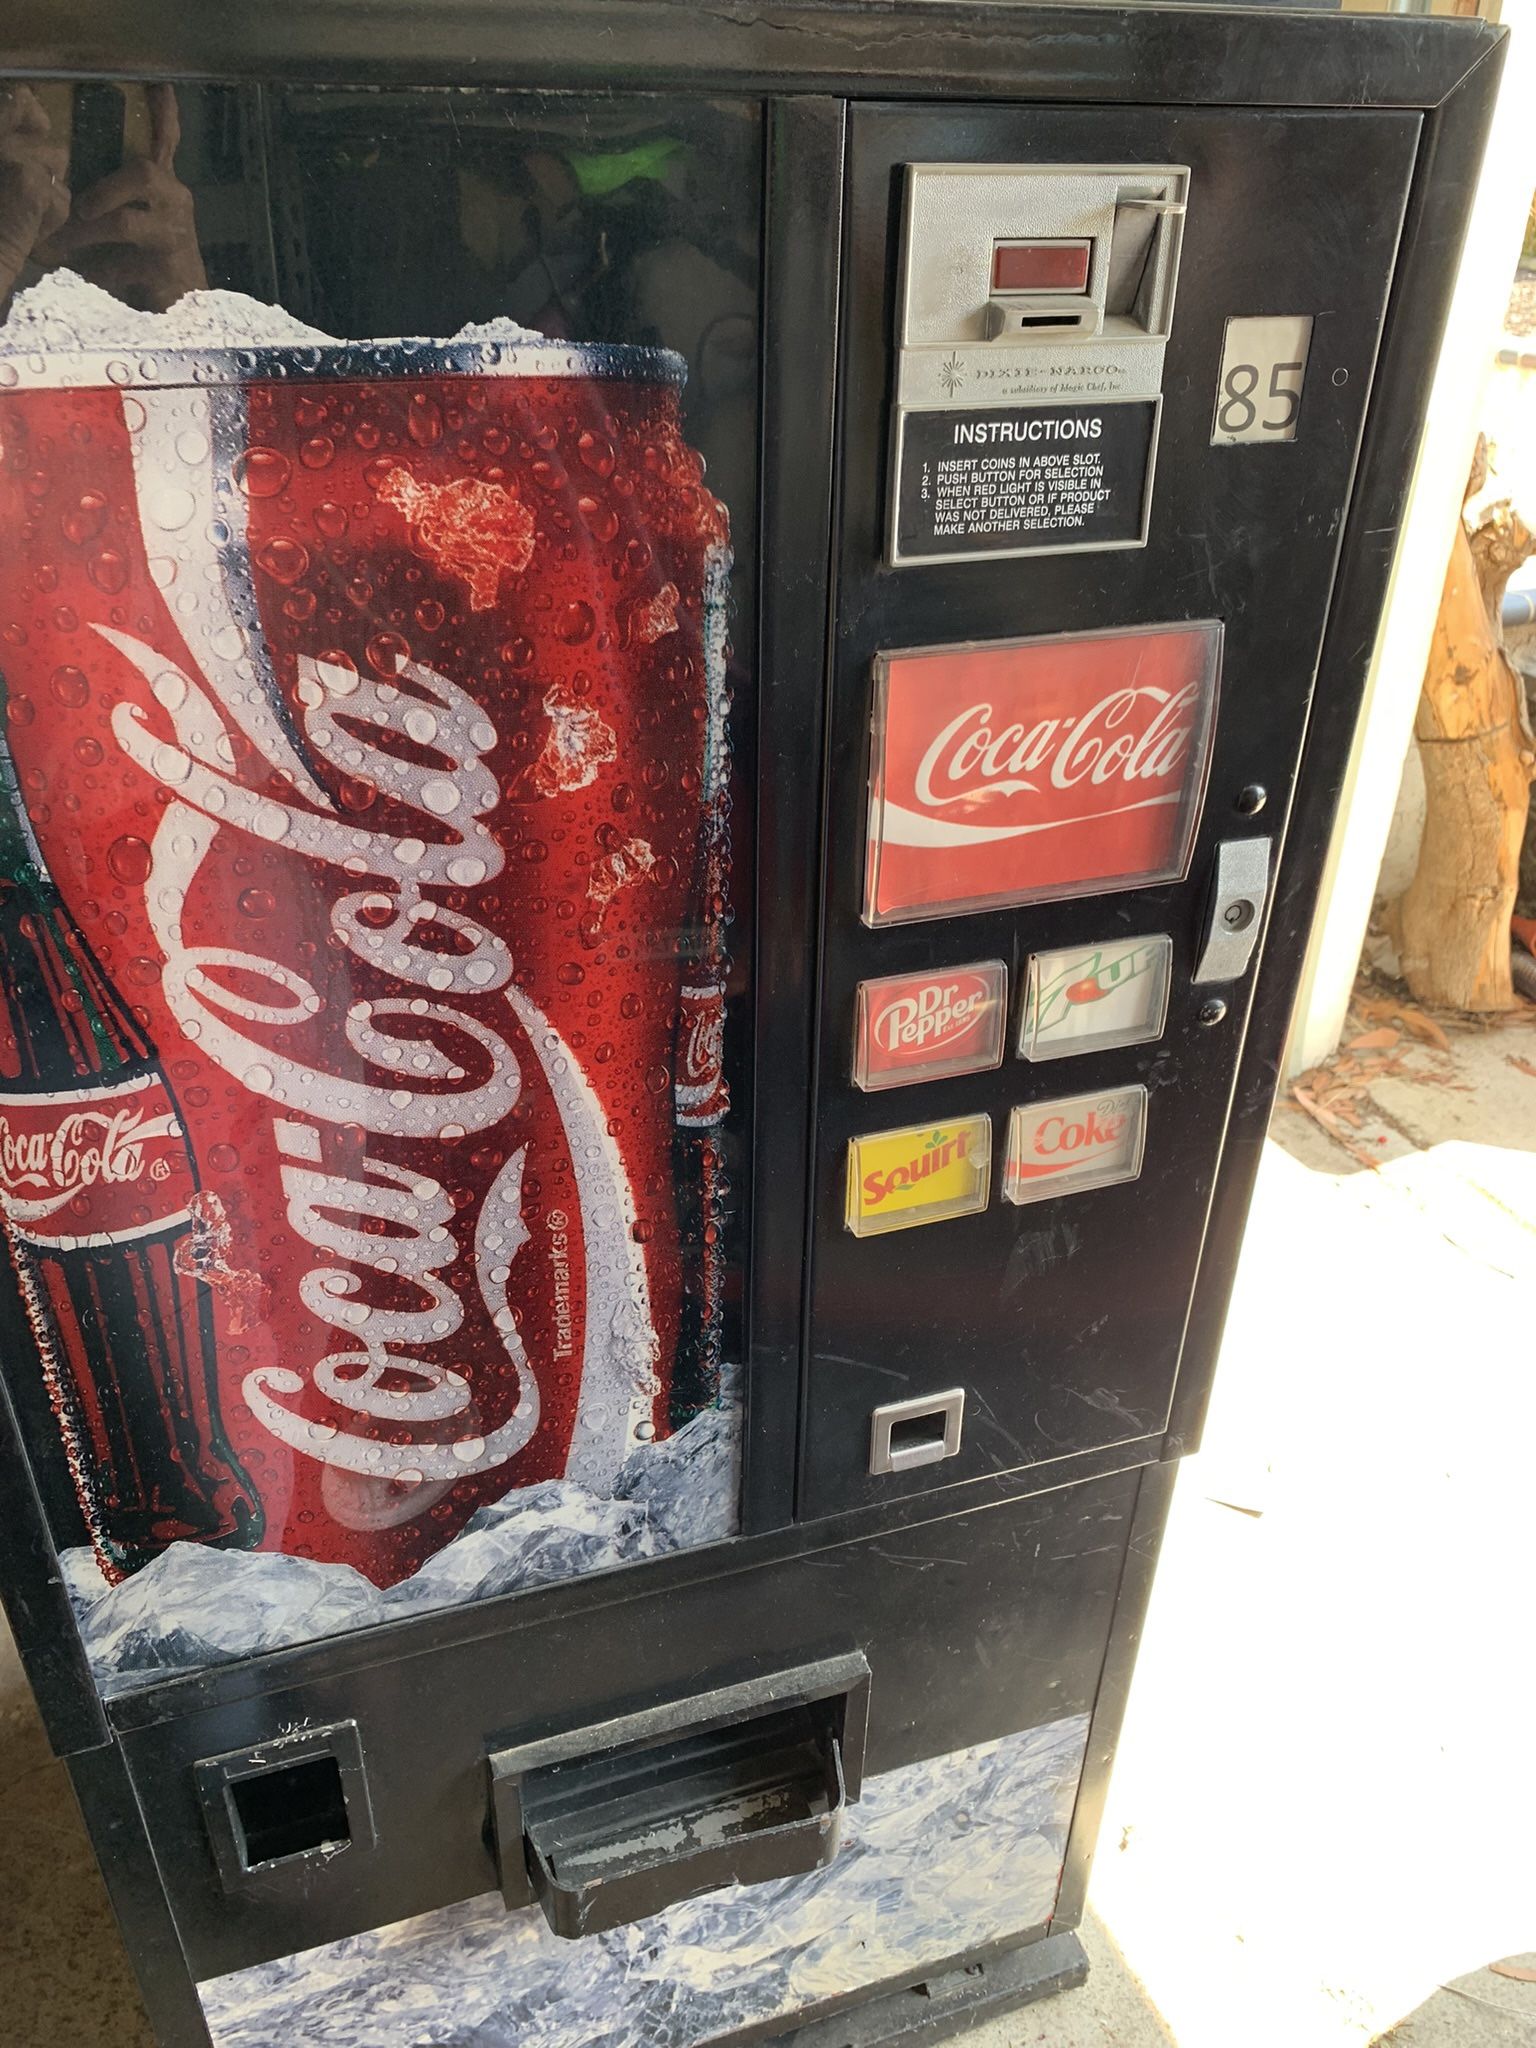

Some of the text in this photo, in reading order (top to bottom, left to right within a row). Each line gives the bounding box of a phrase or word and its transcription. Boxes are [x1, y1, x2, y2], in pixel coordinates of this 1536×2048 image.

[1218, 362, 1302, 432] 85
[954, 419, 1102, 444] INSTRUCTIONS
[922, 453, 1101, 474] 1. INSERT COINS IN ABOVE SLOT.
[922, 465, 1104, 486] 2. PUSH BUTTON FOR SELECTION
[921, 478, 1101, 499] 3. WHEN RED LIGHT IS VISIBLE IN
[935, 489, 1111, 510] SELECT BUTTON OR IF PRODUCT
[934, 516, 1085, 535] MAKE ANOTHER SELECTION.
[935, 503, 1094, 523] WAS NOT DELIVERED, PLEASE
[914, 682, 1199, 806] Coca-Cola
[918, 984, 959, 1019] Dr
[876, 991, 983, 1051] Pepper
[88, 622, 542, 1483] Coca-Cola
[1034, 1112, 1126, 1155] Coke
[863, 1130, 971, 1206] Squirt
